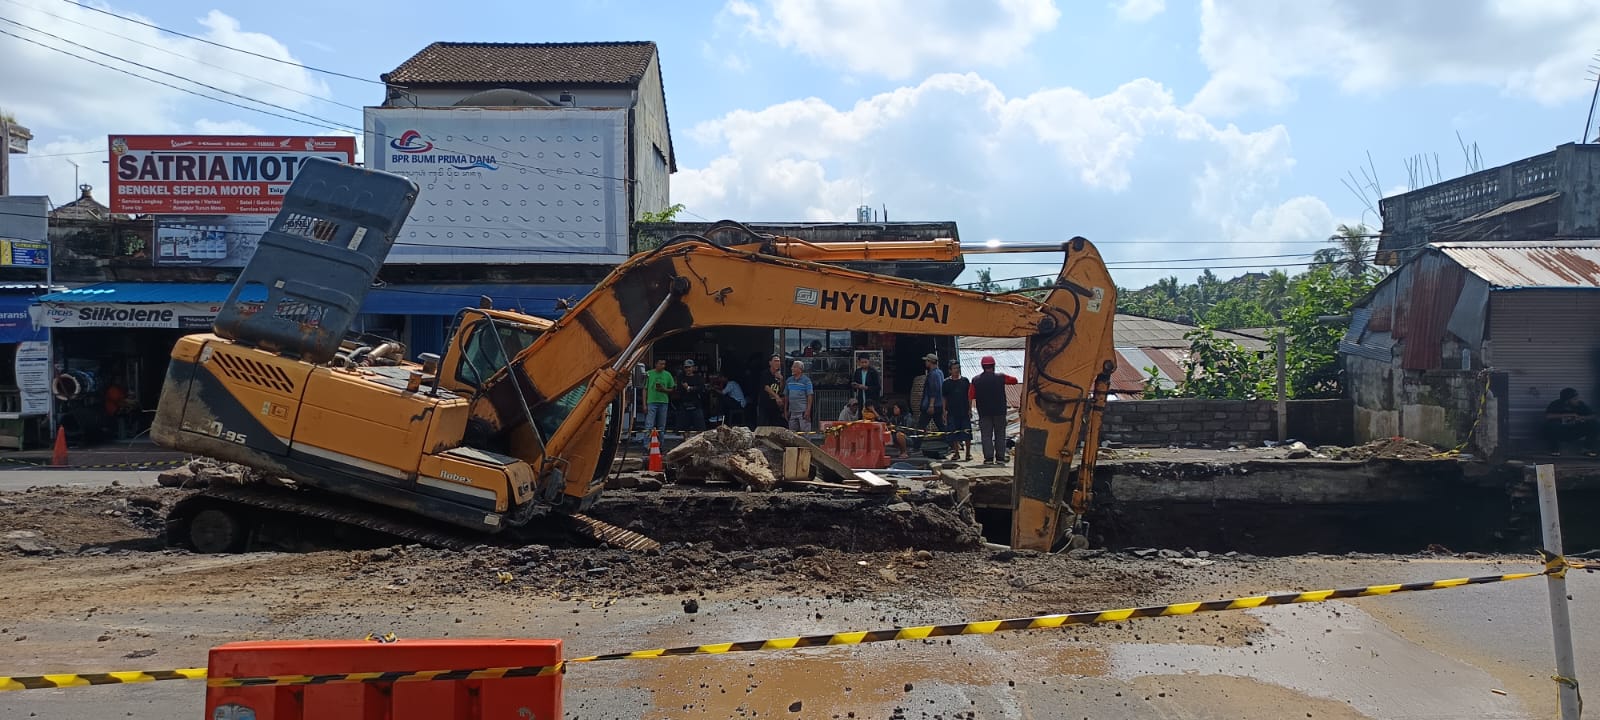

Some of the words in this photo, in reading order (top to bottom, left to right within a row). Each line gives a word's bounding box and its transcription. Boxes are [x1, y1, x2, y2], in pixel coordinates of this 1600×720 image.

[391, 154, 409, 164] BPR
[412, 154, 436, 164] BUMI
[438, 154, 467, 164] PRIMA
[470, 154, 497, 164] DANA
[118, 185, 171, 196] BENGKEL
[173, 185, 218, 196] SEPEDA
[220, 185, 261, 196] MOTOR
[820, 289, 950, 325] HYUNDAI
[78, 306, 175, 322] Silkolene
[440, 470, 474, 483] Robex
